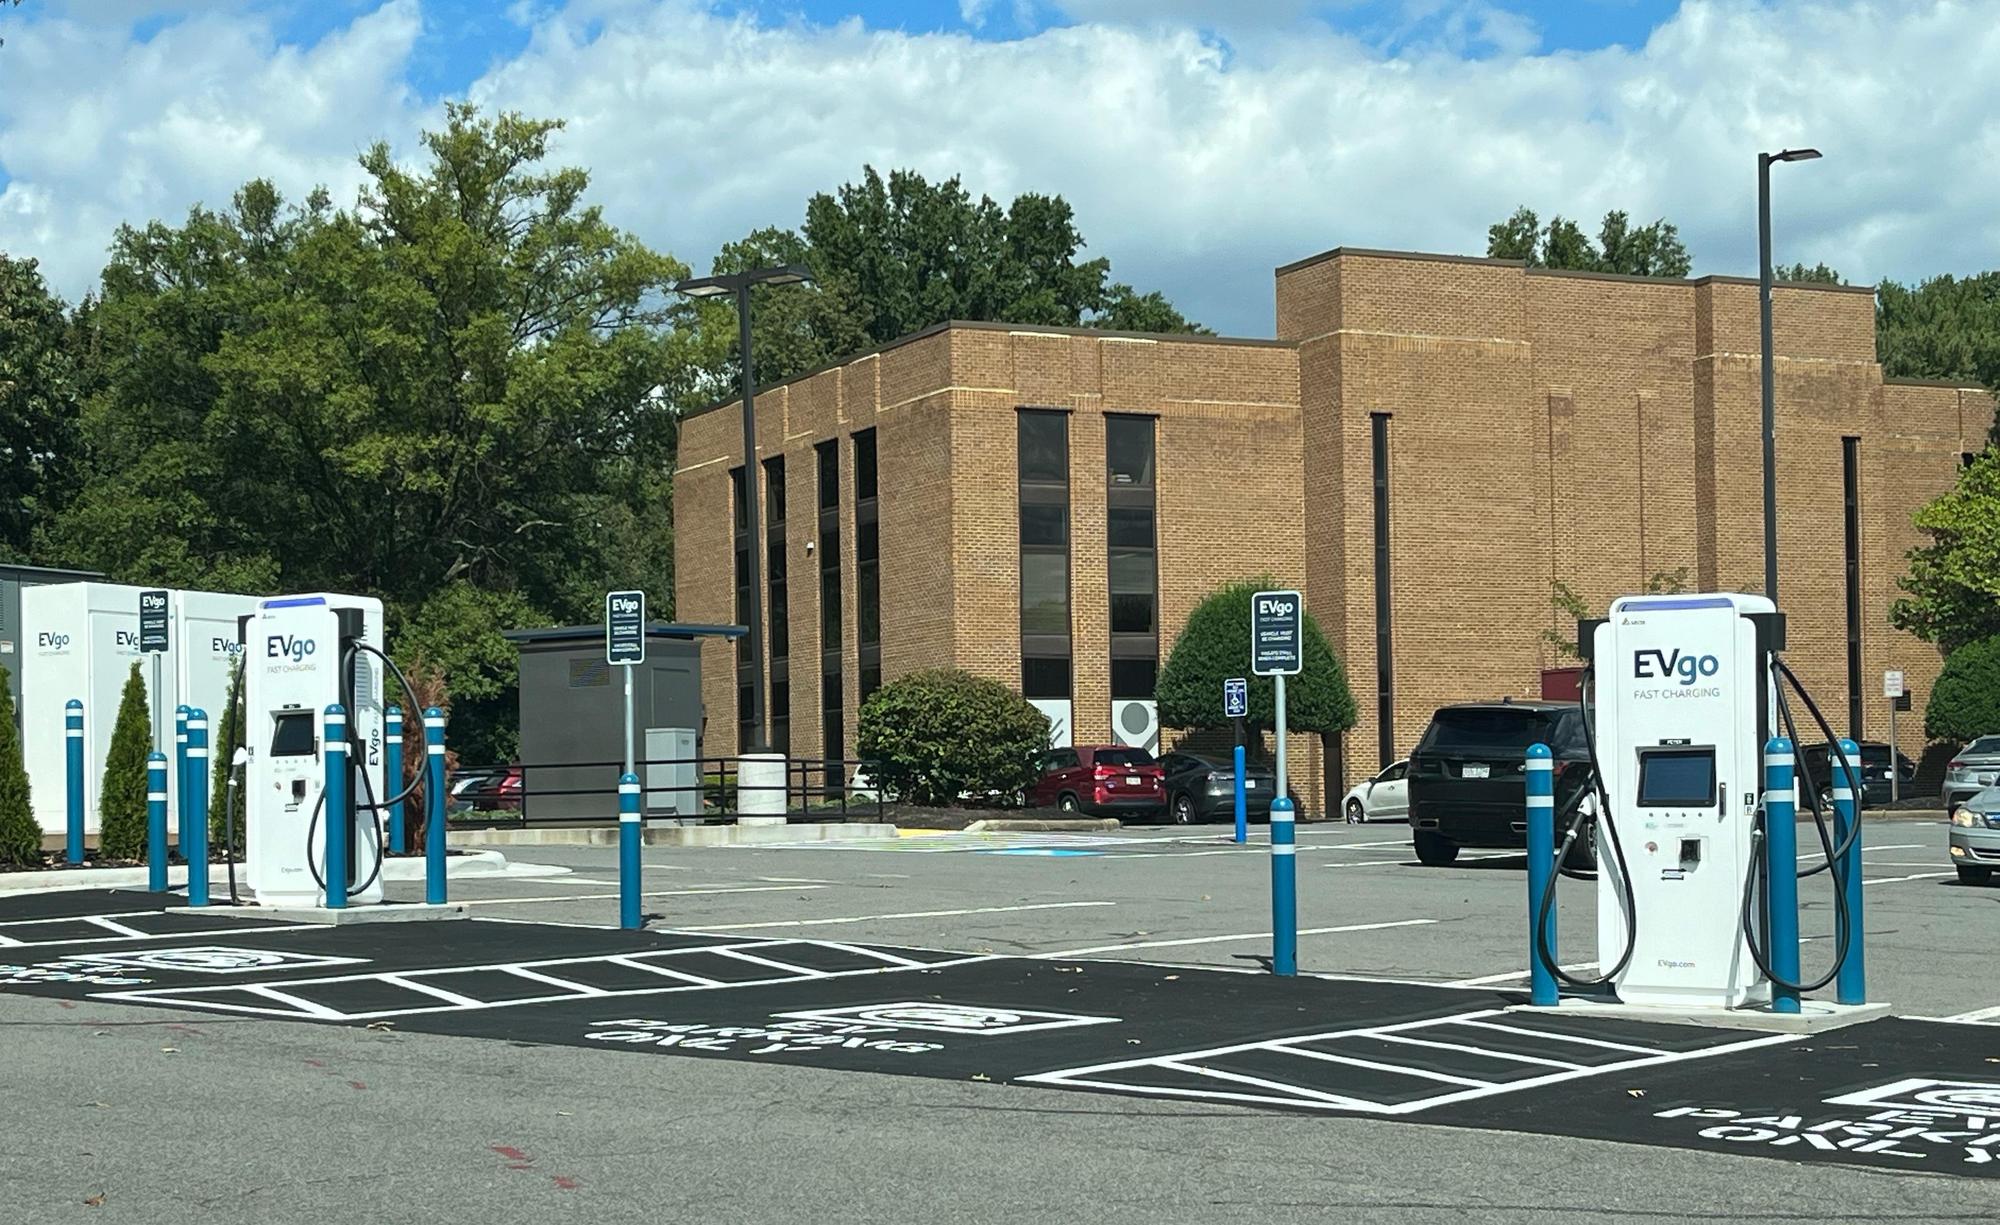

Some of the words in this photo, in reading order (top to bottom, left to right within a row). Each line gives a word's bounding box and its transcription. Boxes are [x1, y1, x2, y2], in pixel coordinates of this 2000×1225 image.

[143, 595, 165, 609] EVgo
[612, 598, 638, 613] EVgo
[1259, 600, 1294, 617] EVgo
[38, 632, 70, 650] EVgo
[116, 631, 139, 650] EVg
[212, 637, 242, 656] EVgo
[267, 634, 316, 663] EVgo
[1634, 648, 1720, 686] EVgo
[1633, 689, 1660, 700] FAST
[1661, 687, 1721, 700] CHARGING
[369, 728, 381, 766] EVgo
[766, 1020, 900, 1034] EV
